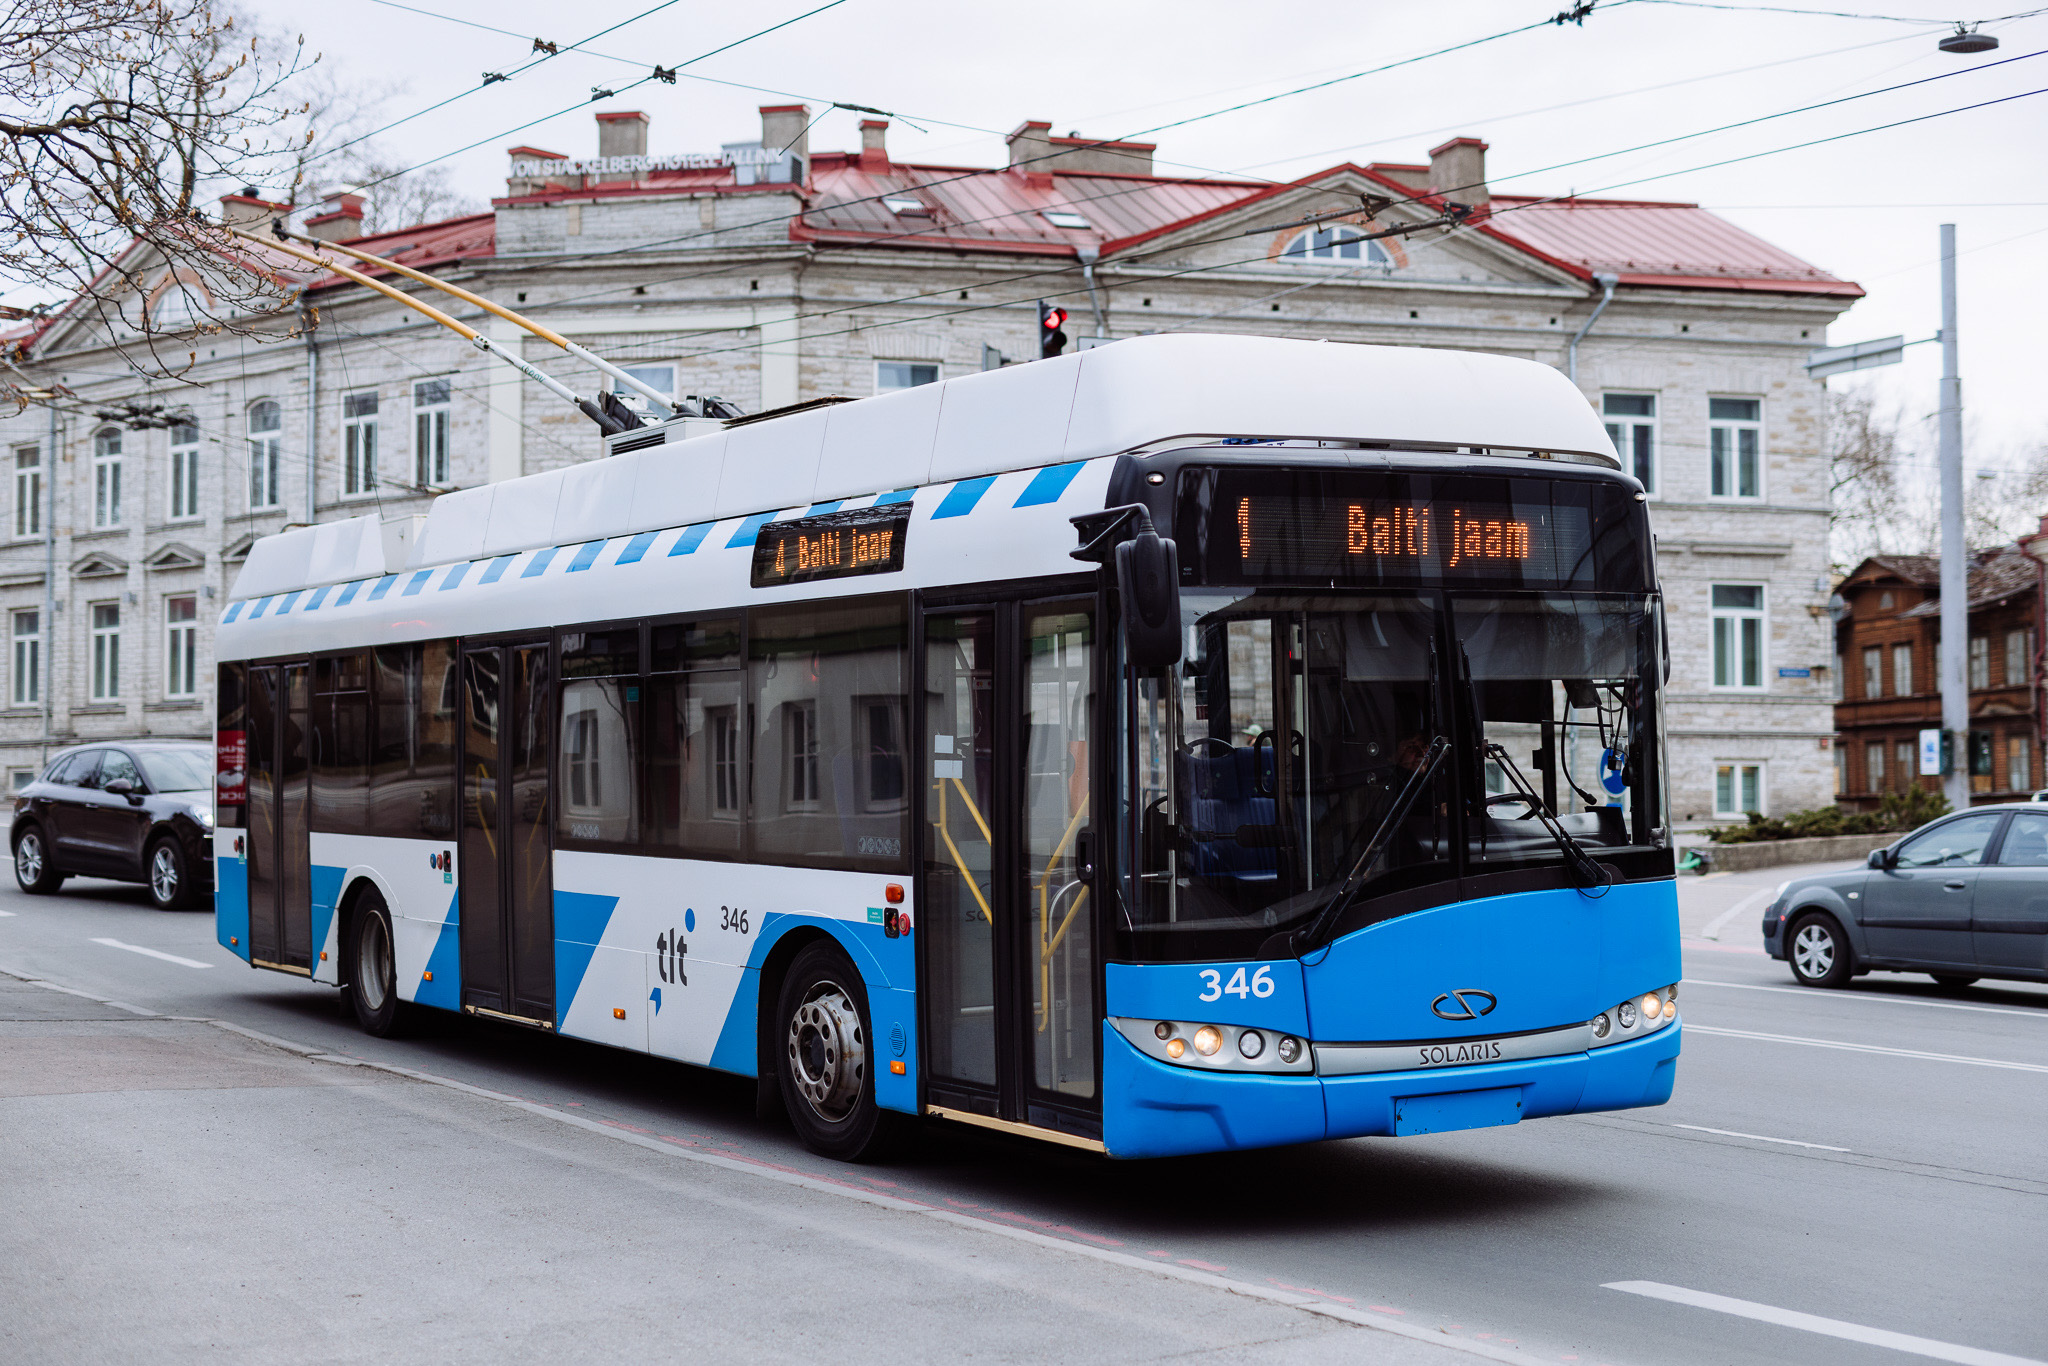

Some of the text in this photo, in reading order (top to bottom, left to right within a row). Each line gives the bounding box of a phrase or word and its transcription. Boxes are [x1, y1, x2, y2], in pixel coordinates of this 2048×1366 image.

[511, 159, 541, 177] VON
[542, 154, 656, 176] STACKELBERG
[721, 147, 783, 167] TALLINN
[775, 528, 893, 576] 4 Balti jaam
[1348, 505, 1429, 555] Balti
[1449, 508, 1529, 567] jaam
[720, 905, 749, 935] 346
[656, 927, 688, 987] tlt
[1198, 964, 1275, 1003] 346
[1419, 1041, 1502, 1067] SOLARIS
